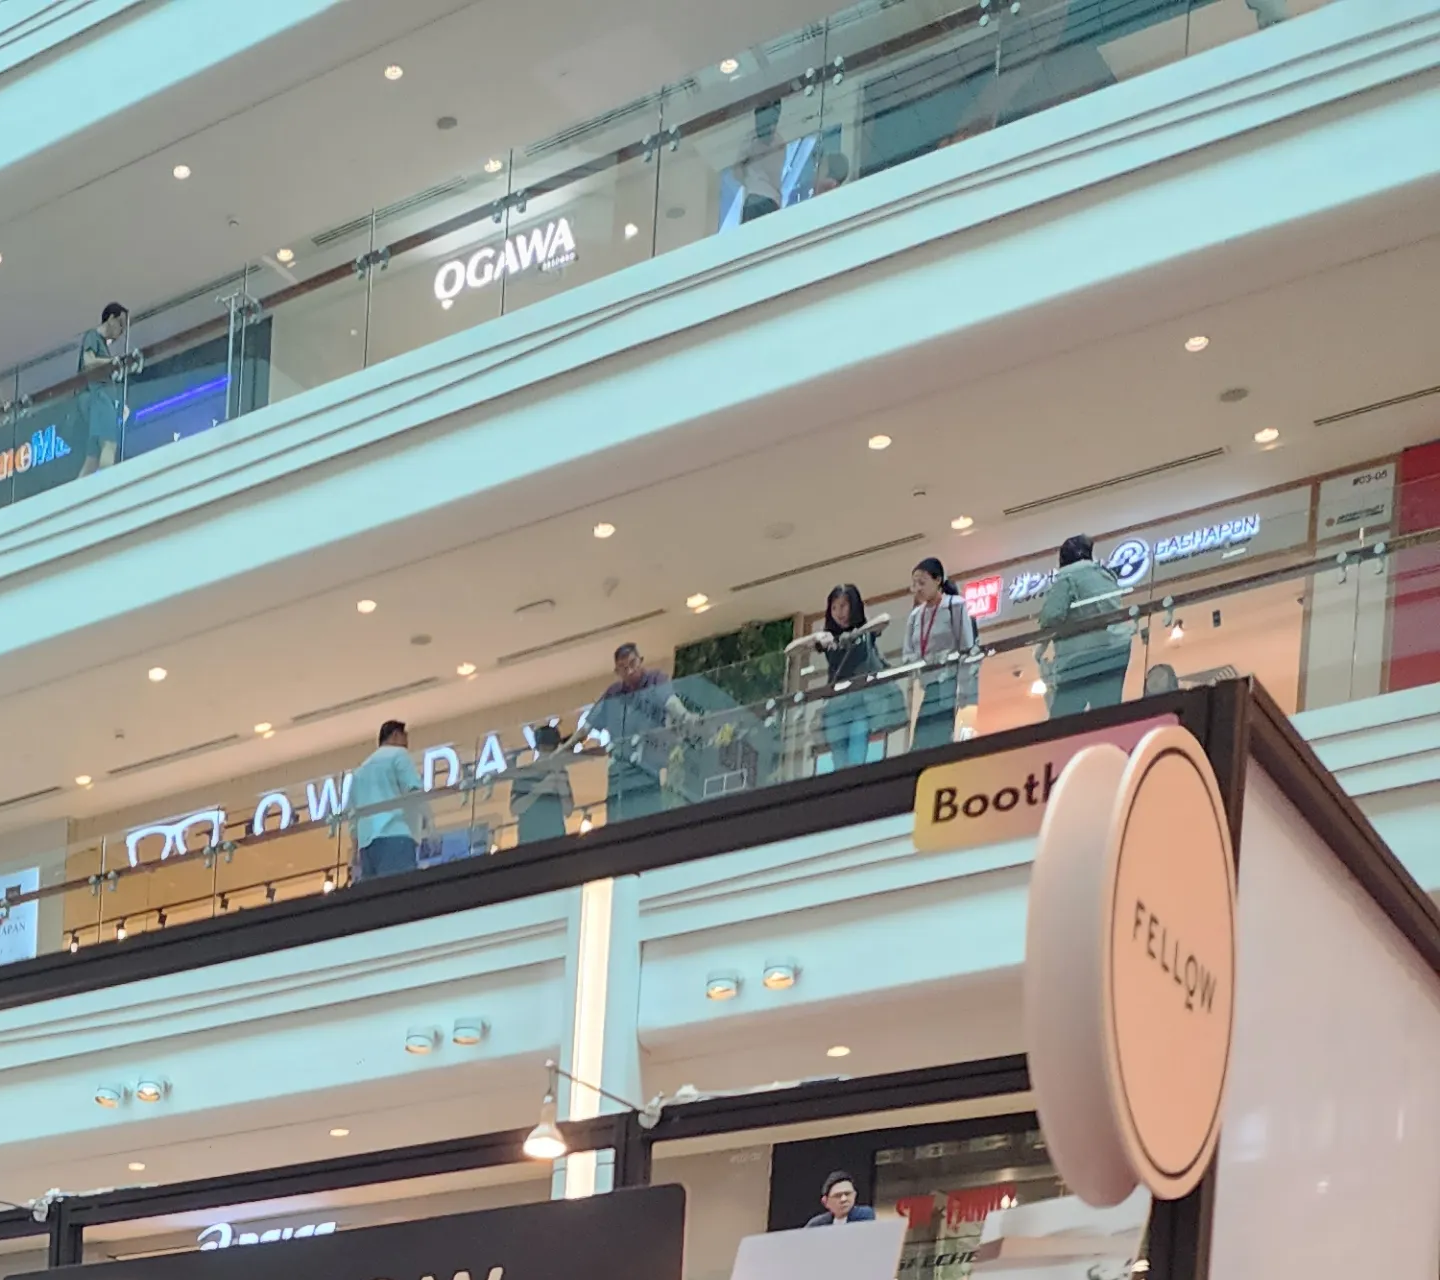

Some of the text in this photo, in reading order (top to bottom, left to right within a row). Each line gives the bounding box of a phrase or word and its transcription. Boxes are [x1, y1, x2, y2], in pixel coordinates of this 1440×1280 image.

[433, 217, 576, 308] OGAWA
[1154, 513, 1260, 561] GASHAPON
[1131, 896, 1217, 1013] FELLOW
